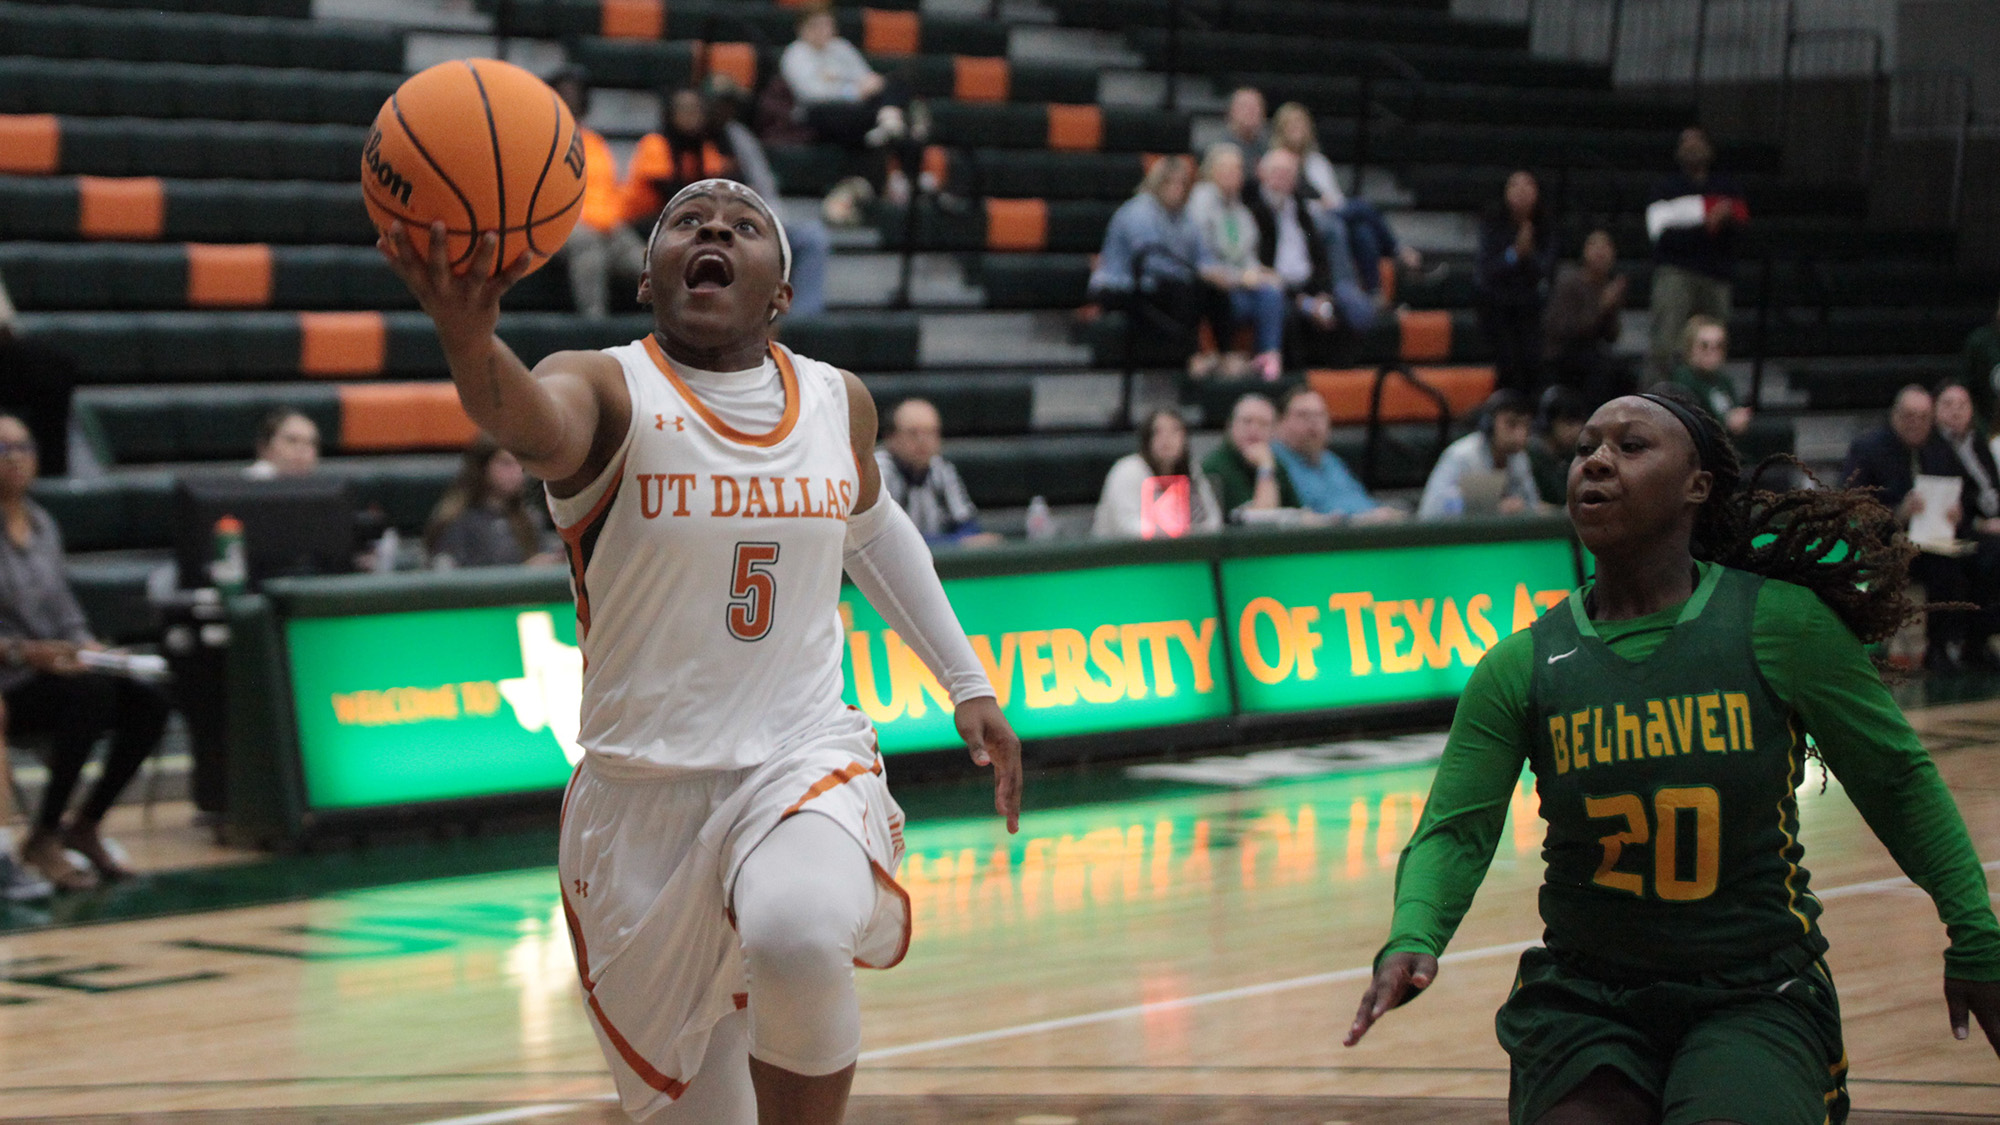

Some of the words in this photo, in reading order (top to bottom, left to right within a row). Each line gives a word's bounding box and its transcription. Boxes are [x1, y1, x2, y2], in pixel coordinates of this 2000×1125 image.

[364, 126, 413, 206] lson
[636, 473, 696, 520] UT
[710, 474, 852, 522] DALLAS
[726, 541, 780, 642] 5
[1328, 591, 1499, 676] TEXAS
[848, 618, 1217, 723] UNVERSITY
[1584, 785, 1720, 901] 20
